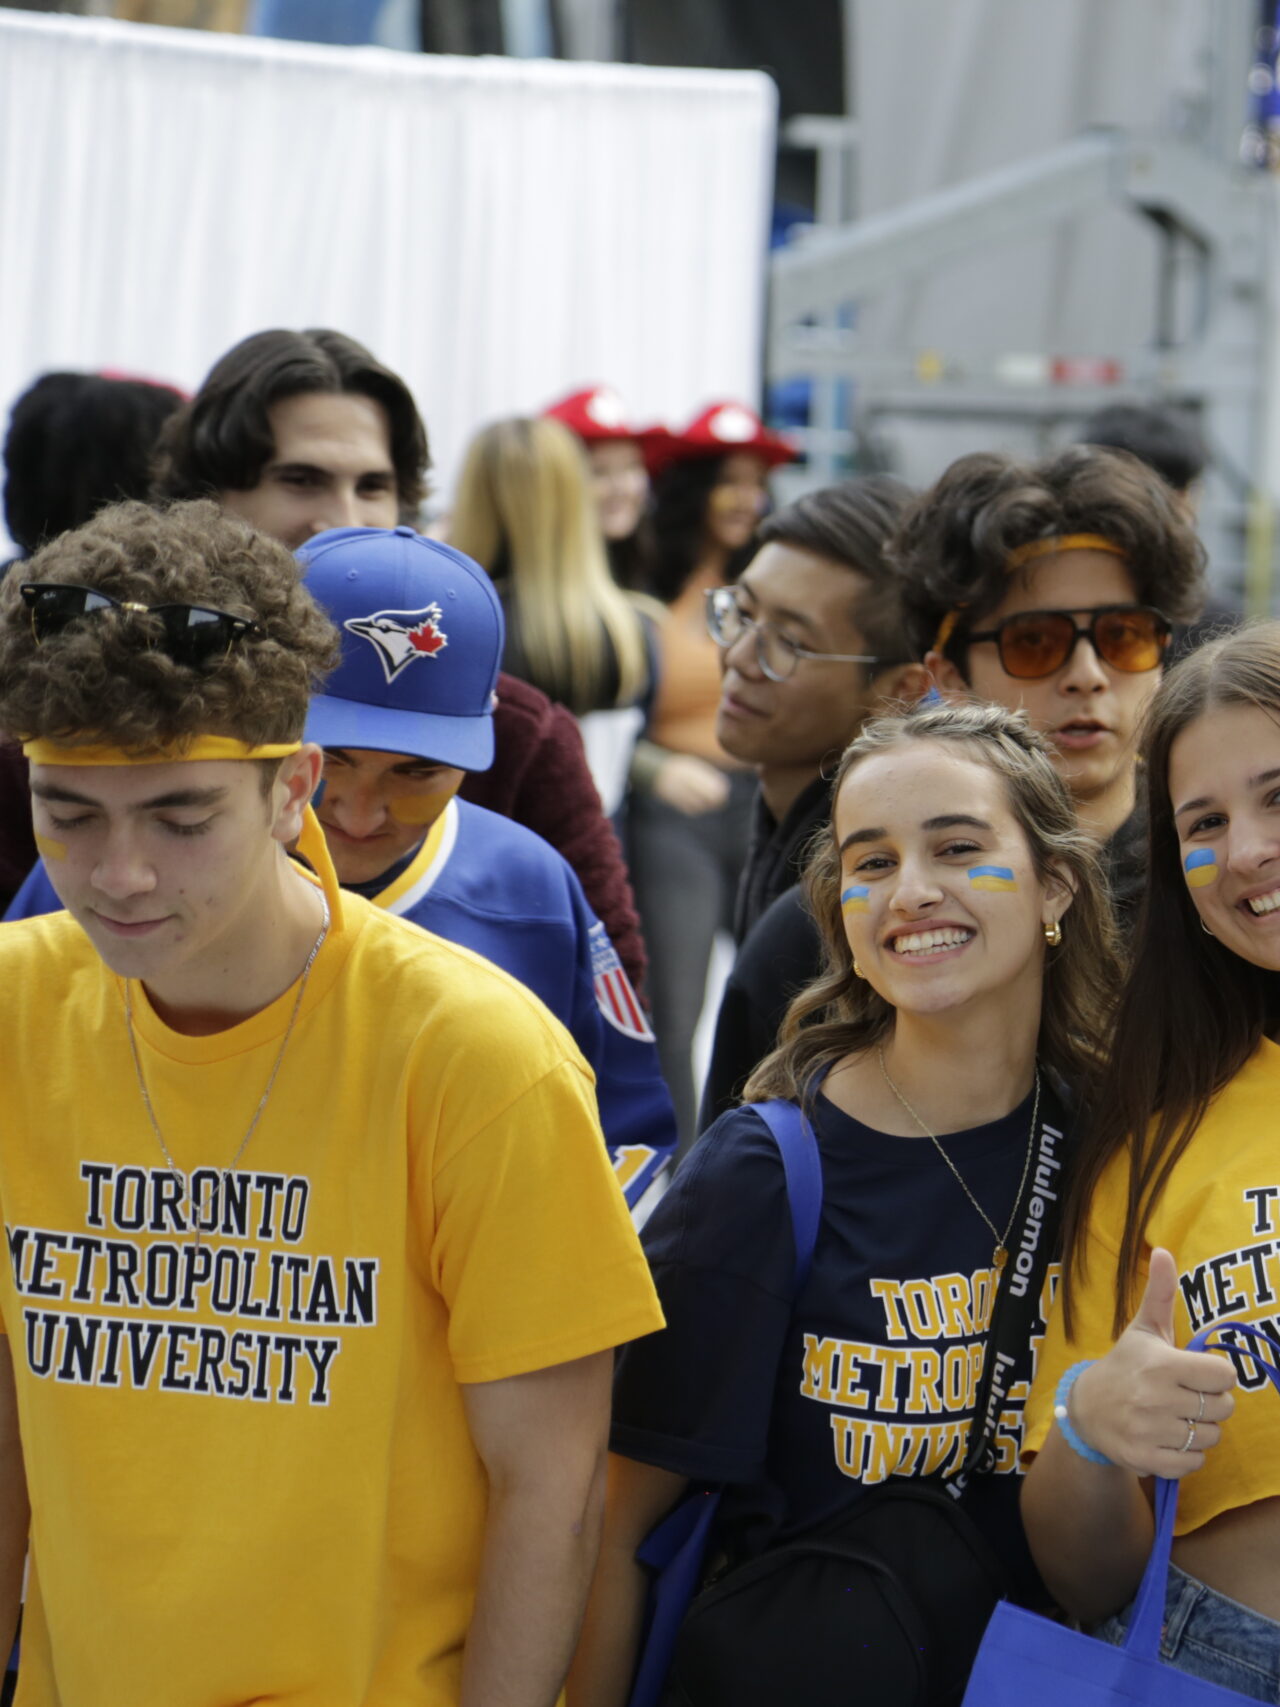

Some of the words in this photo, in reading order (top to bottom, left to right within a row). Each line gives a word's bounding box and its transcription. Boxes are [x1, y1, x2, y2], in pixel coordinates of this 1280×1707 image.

[80, 1160, 311, 1245] TORONTO
[1009, 1123, 1064, 1298] lululemon
[24, 1307, 341, 1406] UNIVERSITY
